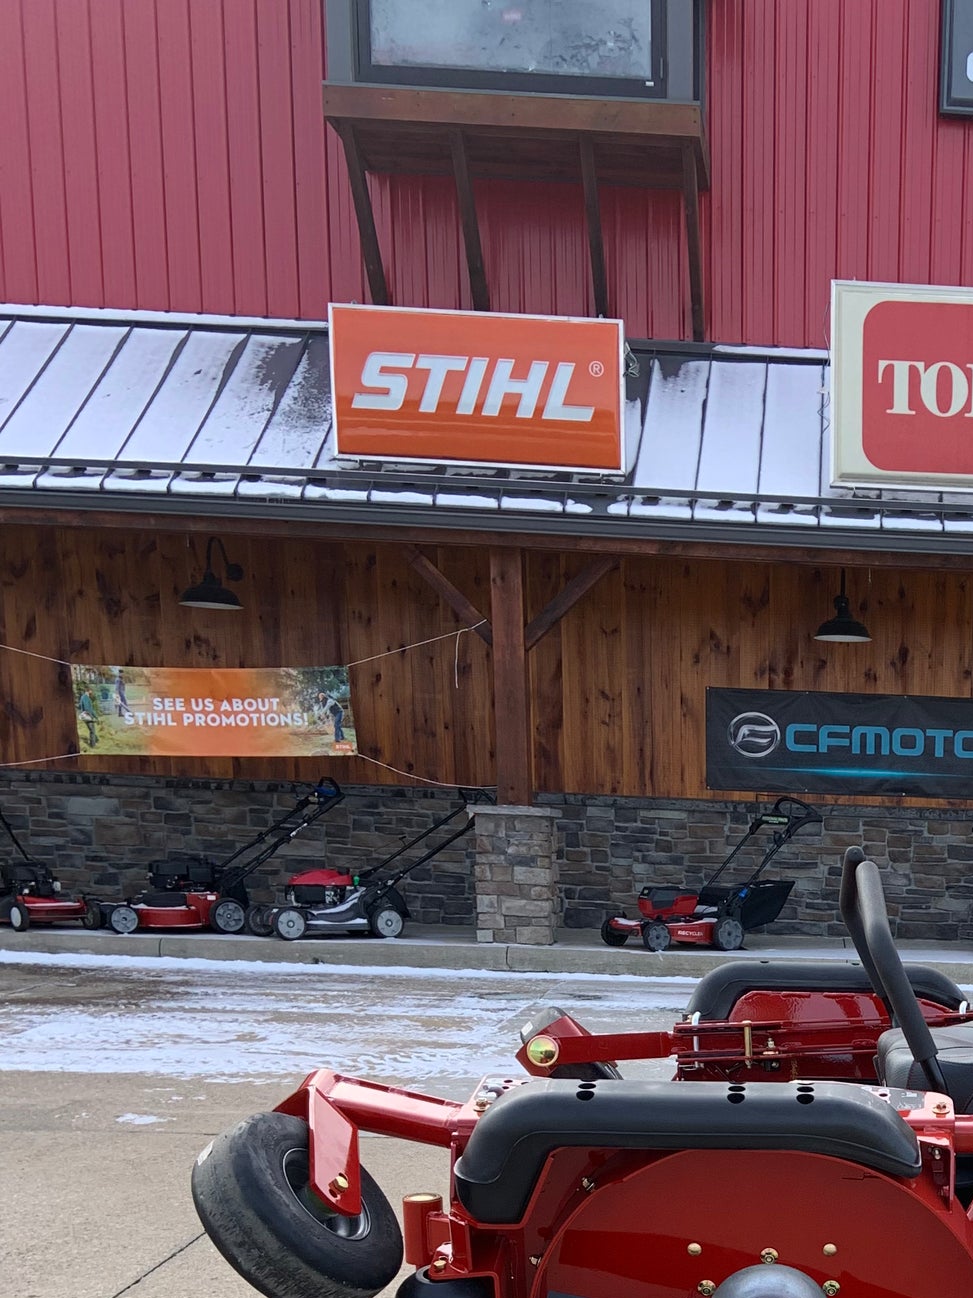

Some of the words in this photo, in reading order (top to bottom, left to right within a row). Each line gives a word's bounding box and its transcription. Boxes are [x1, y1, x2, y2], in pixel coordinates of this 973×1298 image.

[351, 351, 596, 422] STIHL
[152, 697, 186, 711] SEE
[190, 697, 215, 712] US
[220, 698, 280, 712] ABOUT
[123, 711, 177, 726] STIHL
[183, 711, 310, 727] PROMOTIONS!
